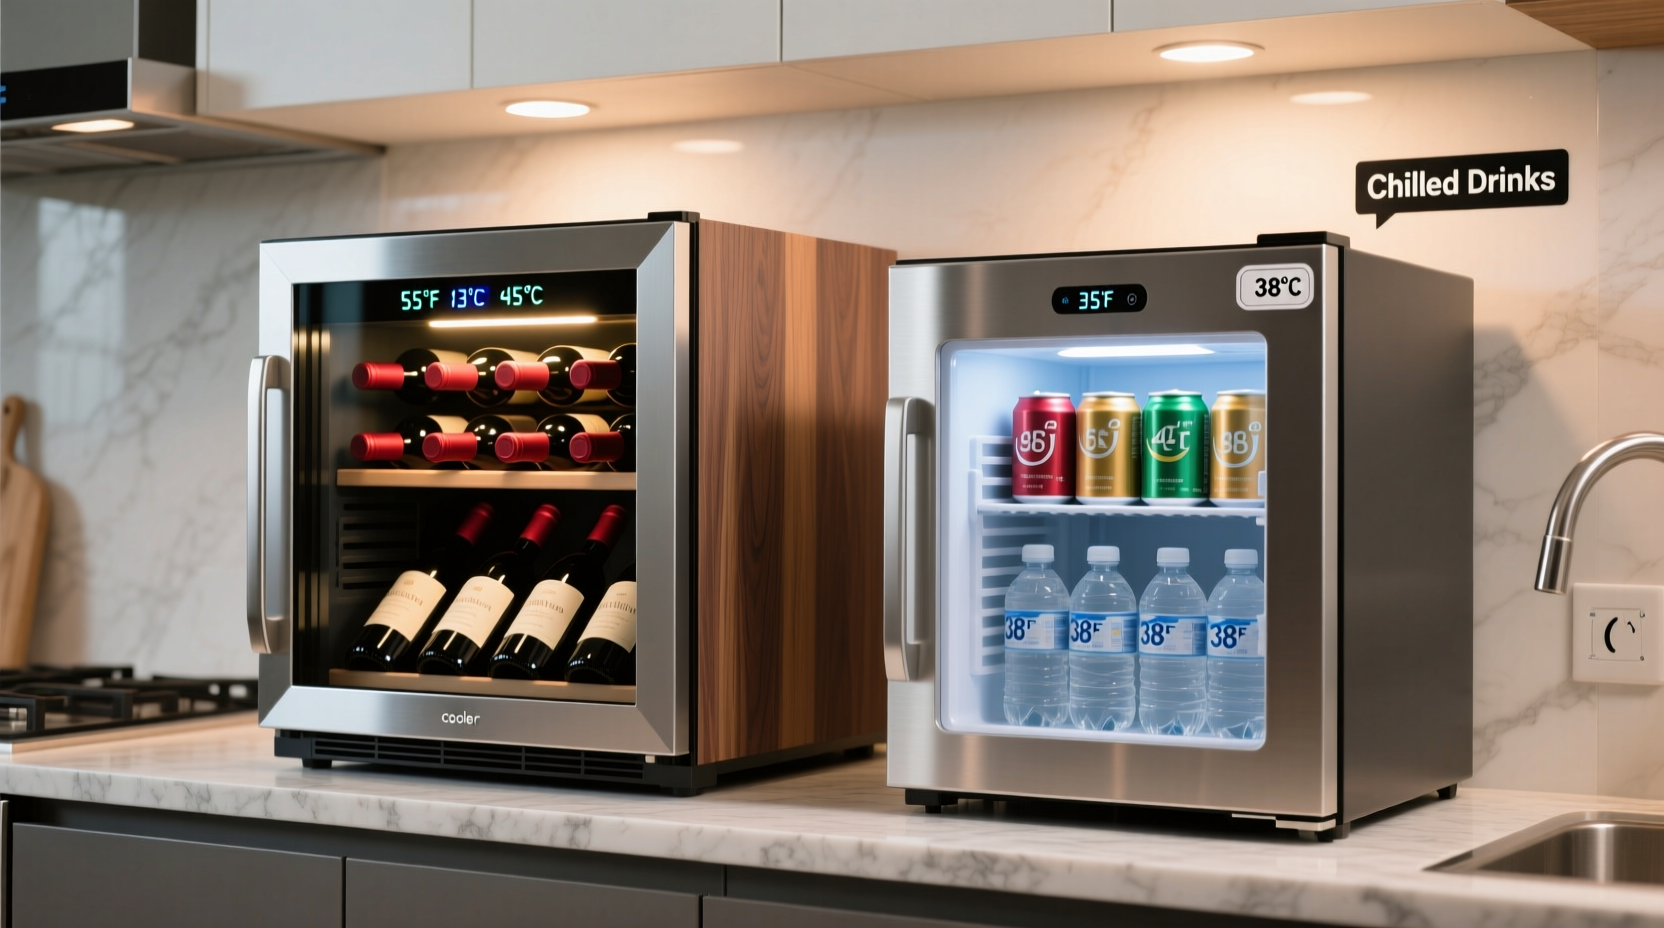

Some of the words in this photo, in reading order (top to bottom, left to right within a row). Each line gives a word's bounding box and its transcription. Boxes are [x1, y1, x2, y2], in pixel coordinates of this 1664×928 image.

[1367, 168, 1460, 200] Chilled
[1467, 164, 1556, 195] Drinks
[400, 289, 440, 311] 55°F
[451, 287, 486, 309] 13°C
[500, 284, 544, 306] 45°C
[1254, 275, 1302, 298] 38°C
[441, 710, 481, 727] cooler
